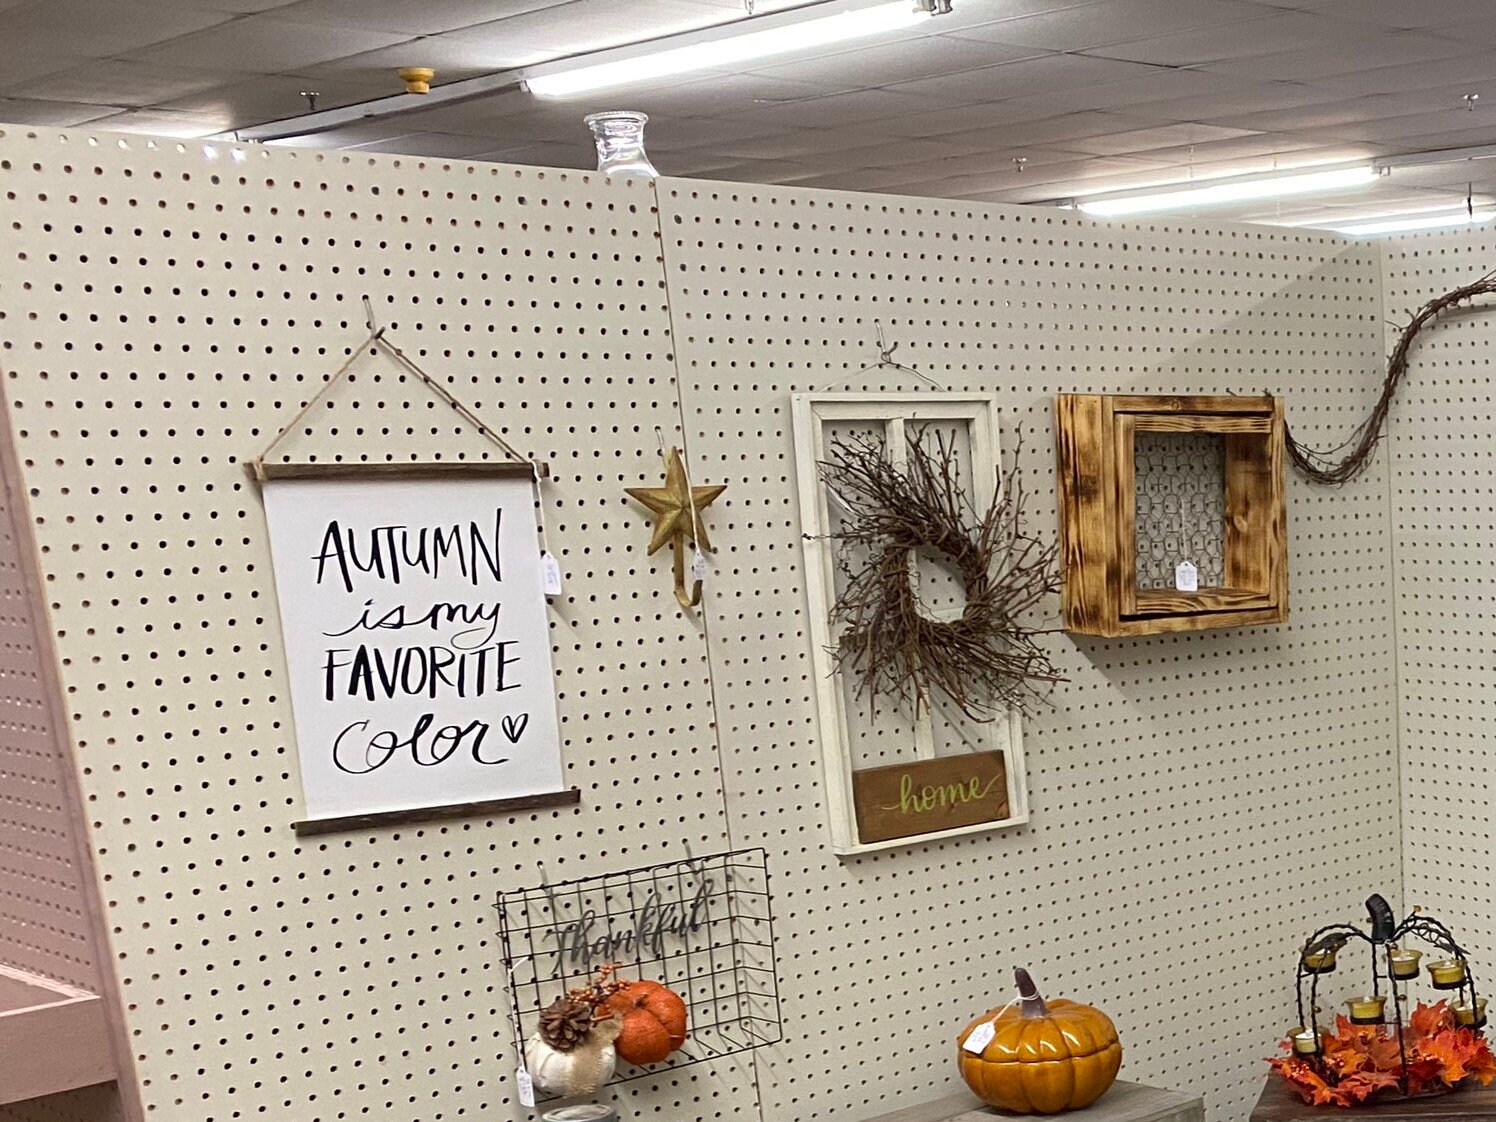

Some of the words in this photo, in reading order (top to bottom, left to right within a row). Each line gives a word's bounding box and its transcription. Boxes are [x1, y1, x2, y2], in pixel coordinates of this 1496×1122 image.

[310, 508, 503, 592] AUTUMN
[322, 599, 407, 637] is
[430, 602, 502, 649] my
[322, 640, 521, 702] FAVORITE
[881, 773, 1002, 815] home
